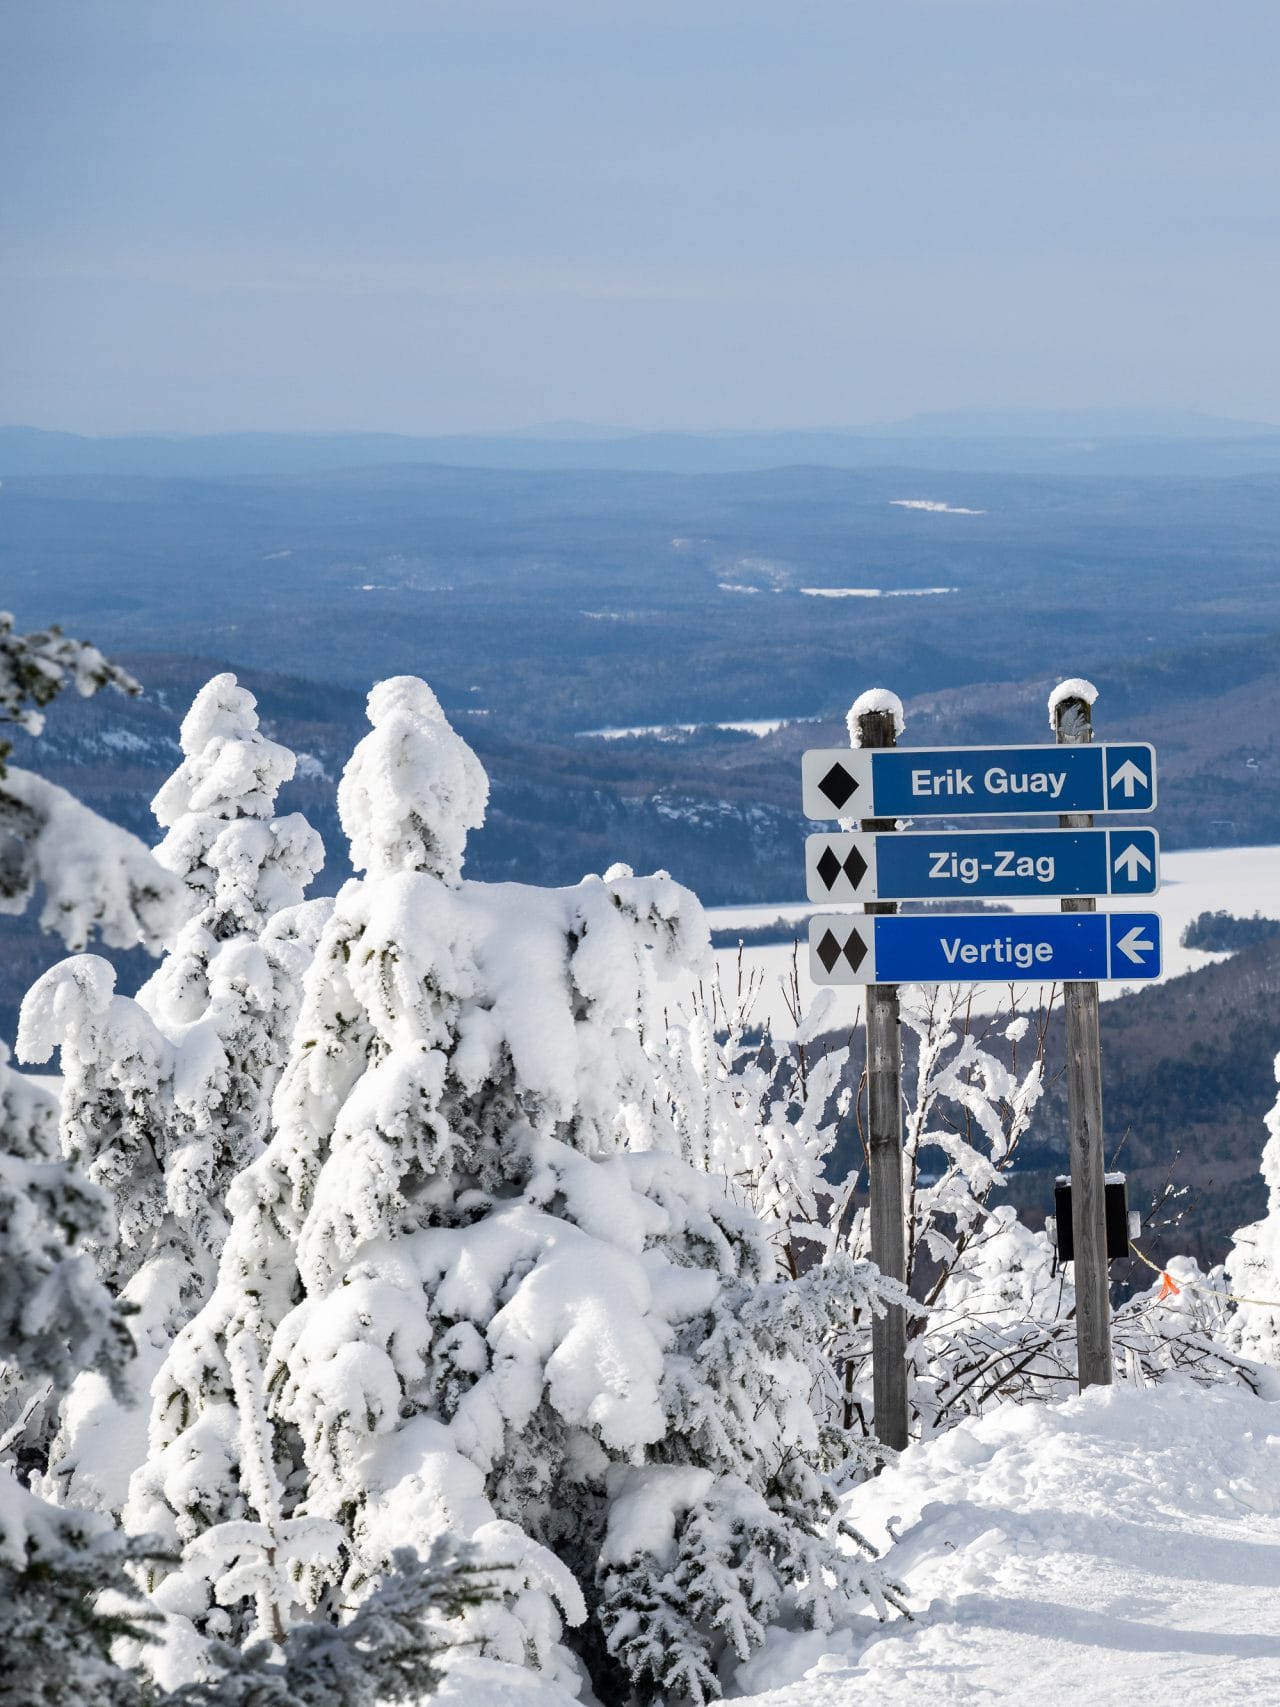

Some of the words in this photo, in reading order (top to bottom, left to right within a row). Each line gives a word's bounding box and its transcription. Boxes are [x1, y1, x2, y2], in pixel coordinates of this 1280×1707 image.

[911, 769, 974, 796] Erik
[984, 767, 1066, 798] Guay
[928, 850, 1056, 884] Zig-Zag
[939, 937, 1054, 968] Vertige
